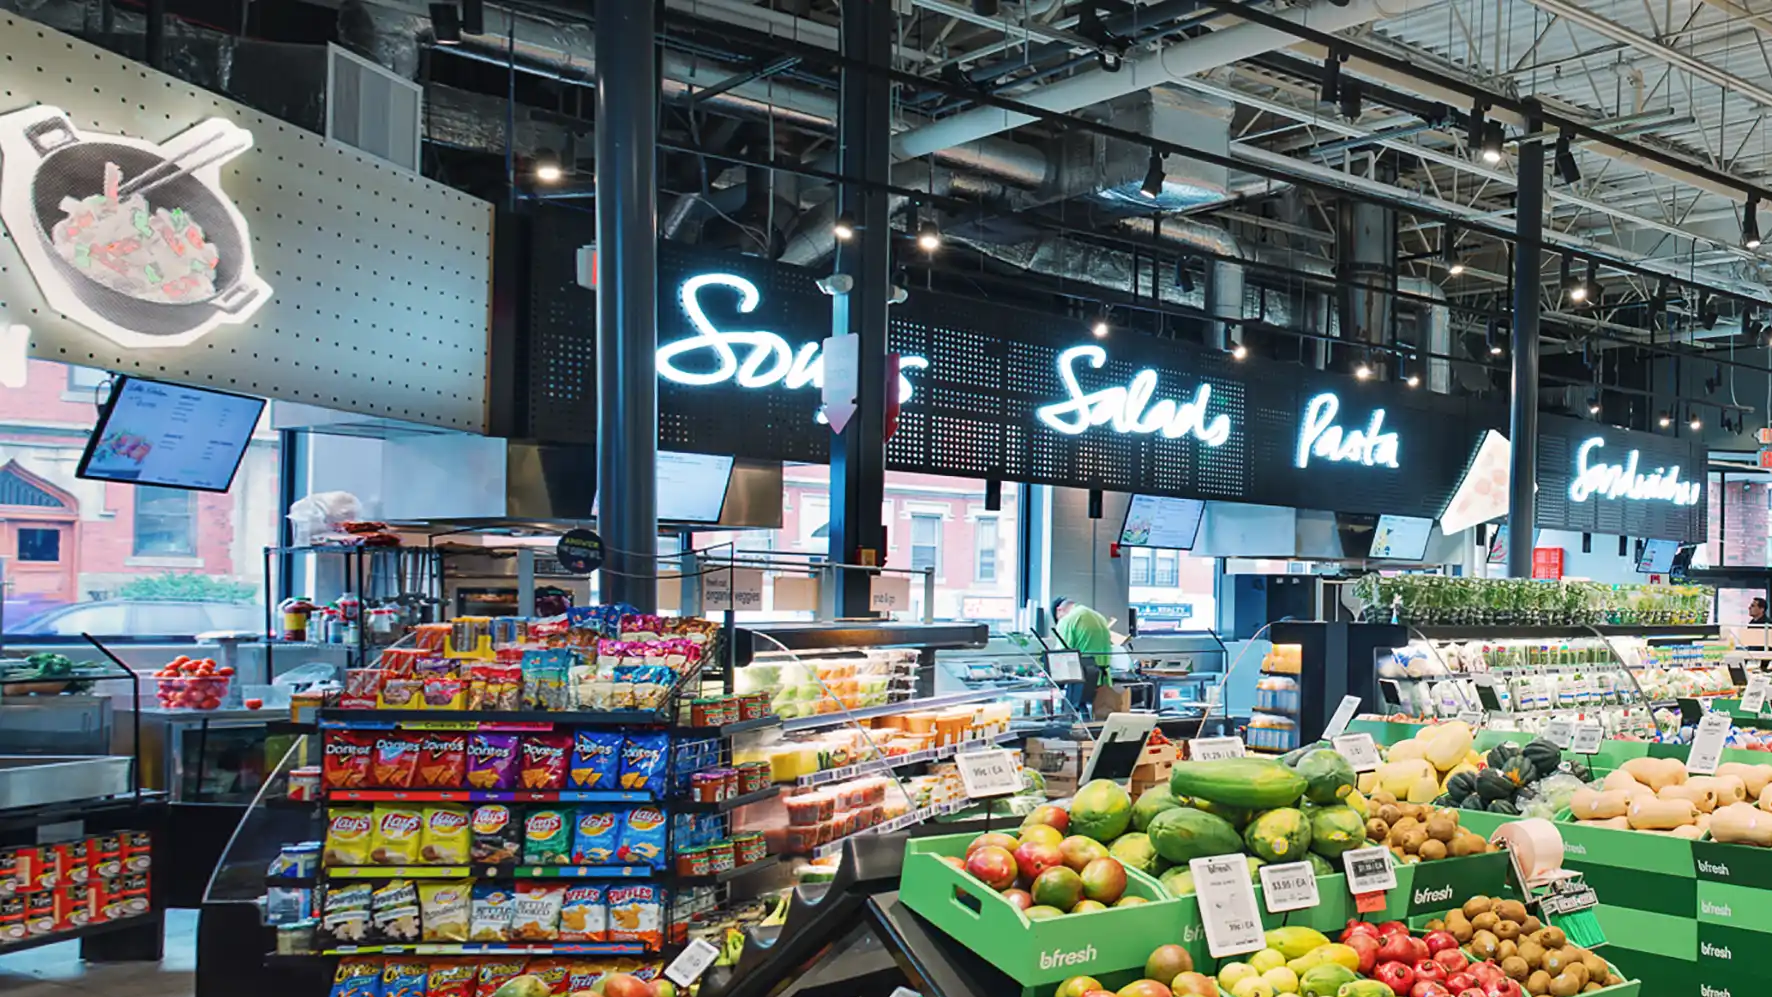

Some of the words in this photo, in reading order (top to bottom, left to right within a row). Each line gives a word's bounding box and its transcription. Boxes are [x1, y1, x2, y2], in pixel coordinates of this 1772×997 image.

[1036, 344, 1231, 448] Salads
[1294, 391, 1400, 469] Pasta
[1569, 436, 1700, 506] Sandwiches
[1697, 859, 1730, 876] bfresh
[608, 886, 653, 904] RUFFLES
[1414, 884, 1453, 905] bfresh
[1701, 899, 1732, 917] bfresh
[1040, 944, 1097, 970] bfresh
[1701, 941, 1732, 960] bfresh
